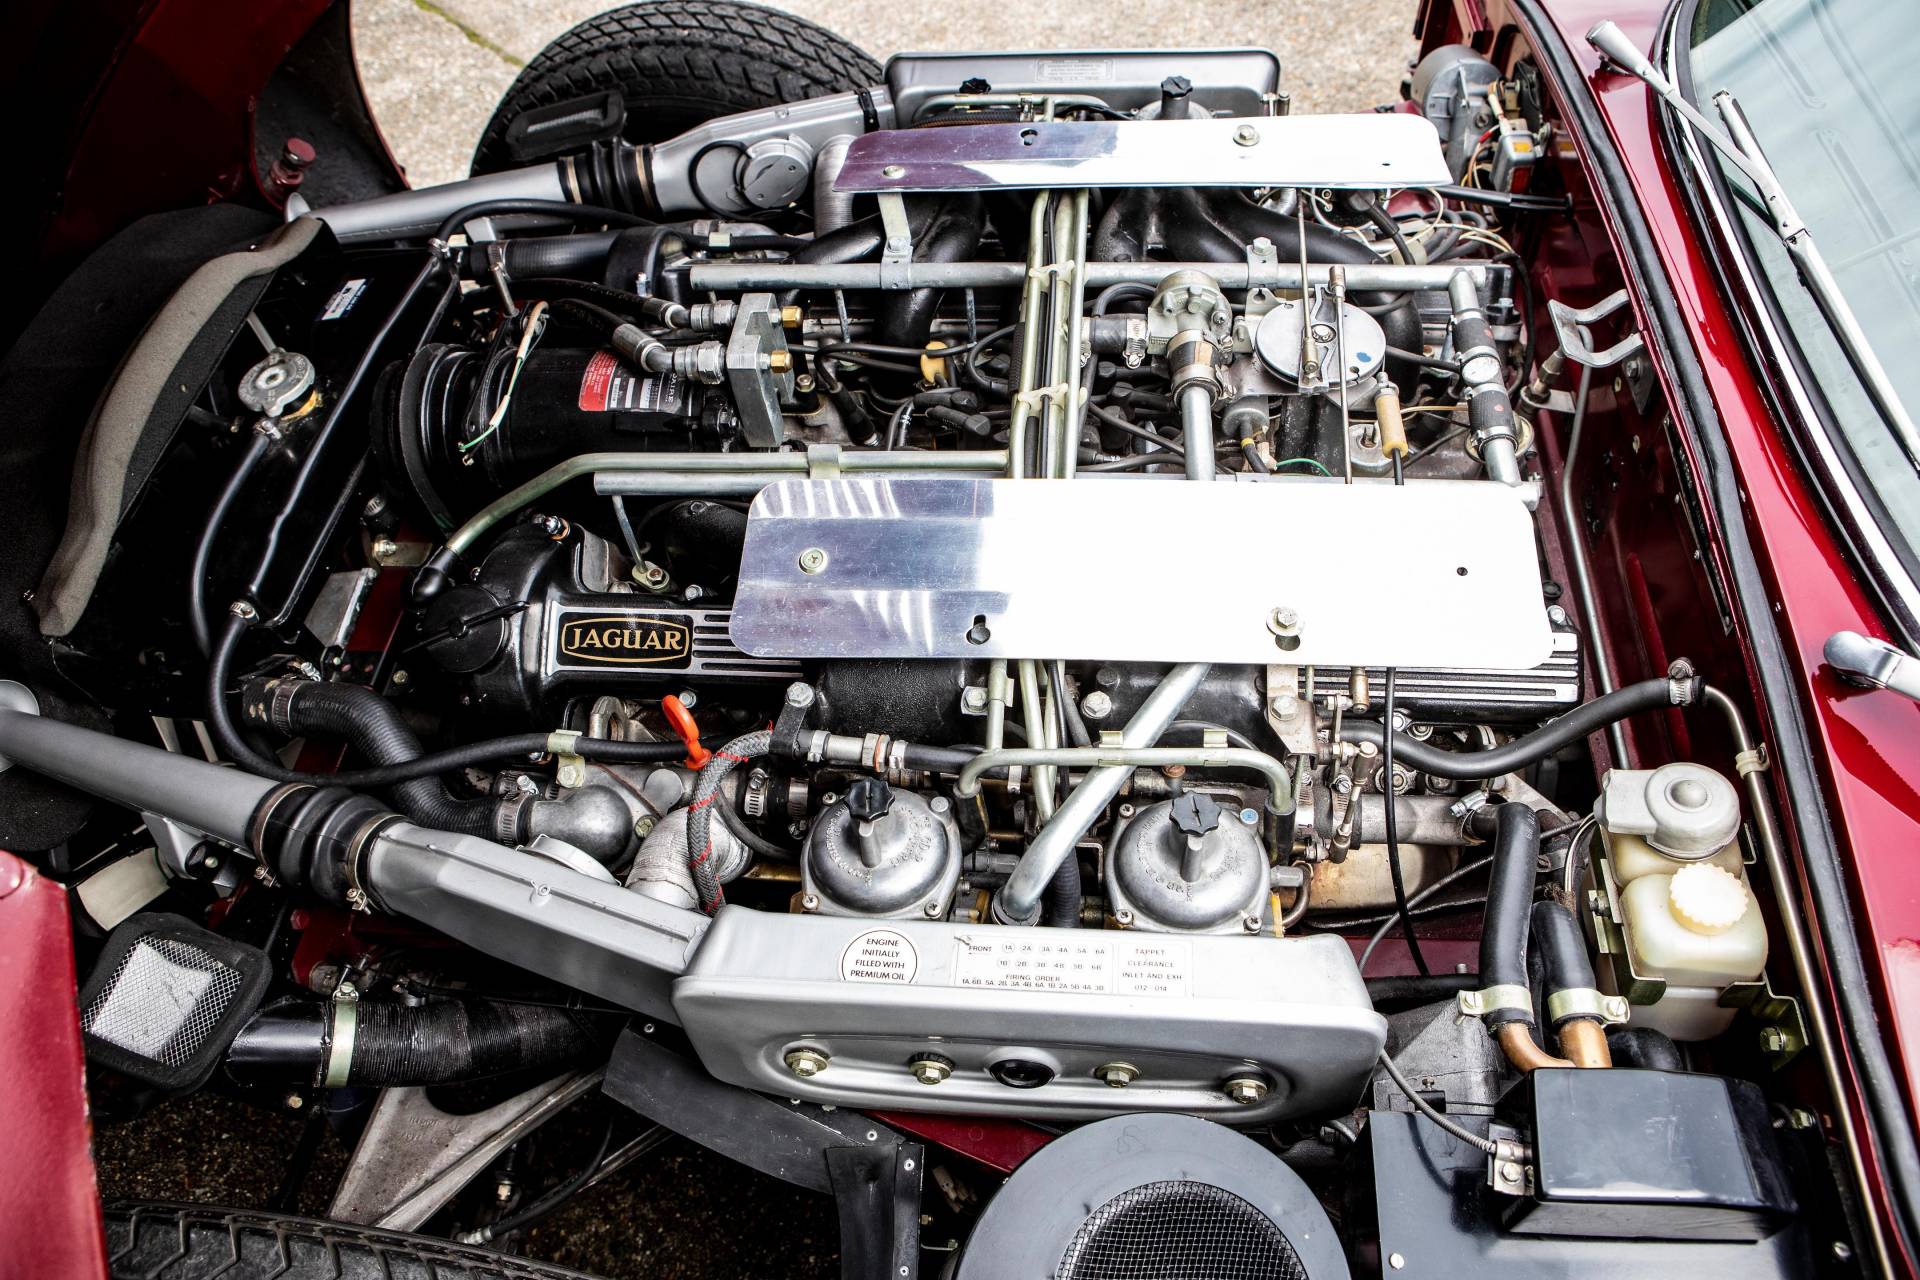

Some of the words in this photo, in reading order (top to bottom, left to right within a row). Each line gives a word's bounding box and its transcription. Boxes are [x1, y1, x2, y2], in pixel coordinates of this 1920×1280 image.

[567, 628, 683, 650] JAGUAR
[866, 938, 900, 947] ENGINE
[862, 948, 900, 958] INITIALLY
[855, 959, 881, 968] FILLED
[882, 961, 905, 969] WITH
[850, 969, 890, 980] PREMIUM
[891, 972, 905, 981] OIL
